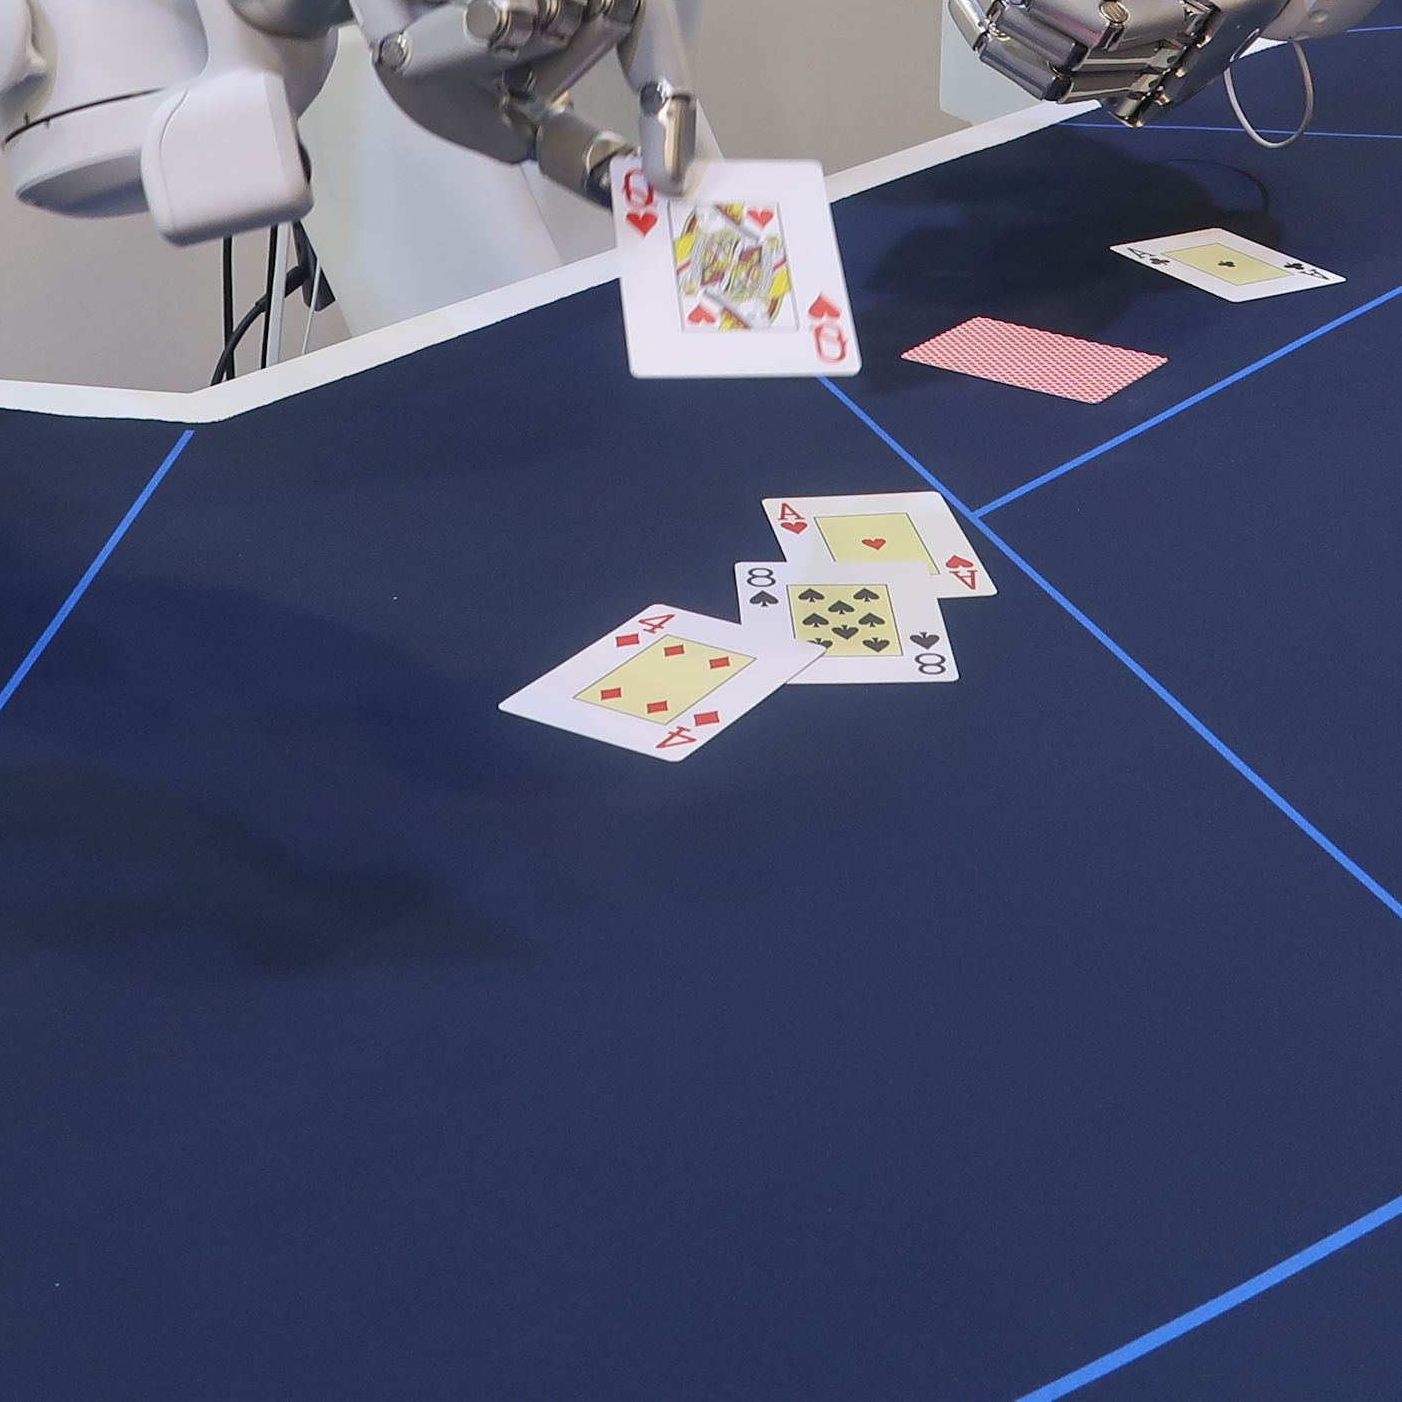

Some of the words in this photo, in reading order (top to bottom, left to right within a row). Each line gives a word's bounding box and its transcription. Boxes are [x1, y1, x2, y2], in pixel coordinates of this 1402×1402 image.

[623, 168, 658, 209] Q
[1127, 247, 1154, 260] A
[1298, 268, 1330, 281] A
[809, 324, 848, 365] Q
[777, 502, 806, 522] A
[747, 568, 776, 588] 8
[948, 569, 979, 591] A
[638, 613, 677, 635] 4
[915, 652, 948, 675] 8
[656, 726, 697, 750] 4
